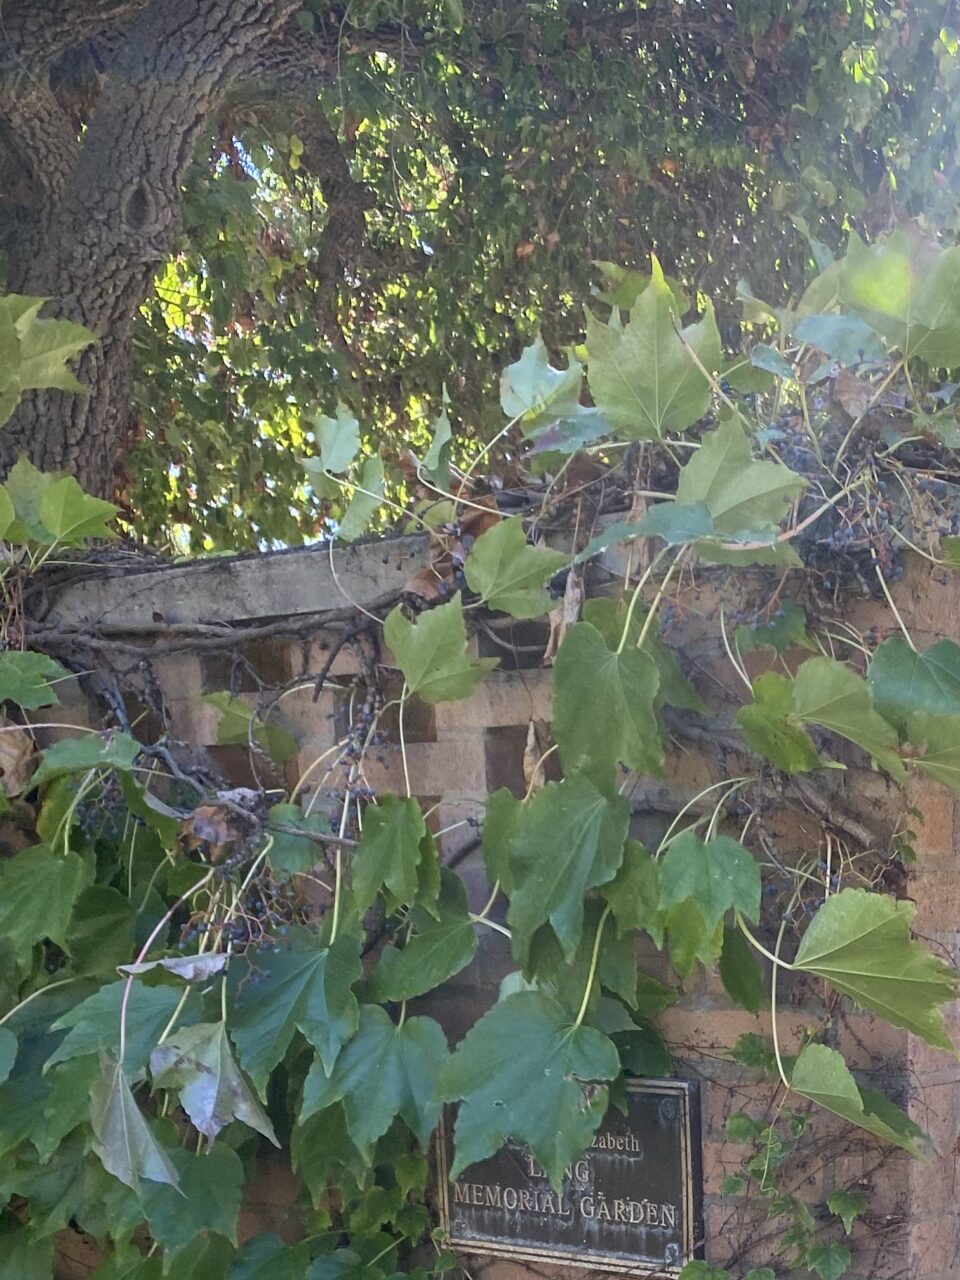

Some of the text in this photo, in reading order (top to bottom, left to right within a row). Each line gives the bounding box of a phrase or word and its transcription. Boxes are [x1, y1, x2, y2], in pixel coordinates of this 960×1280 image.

[527, 1155, 590, 1183] LNG
[454, 1182, 676, 1228] MEMORIAL GARDEN
